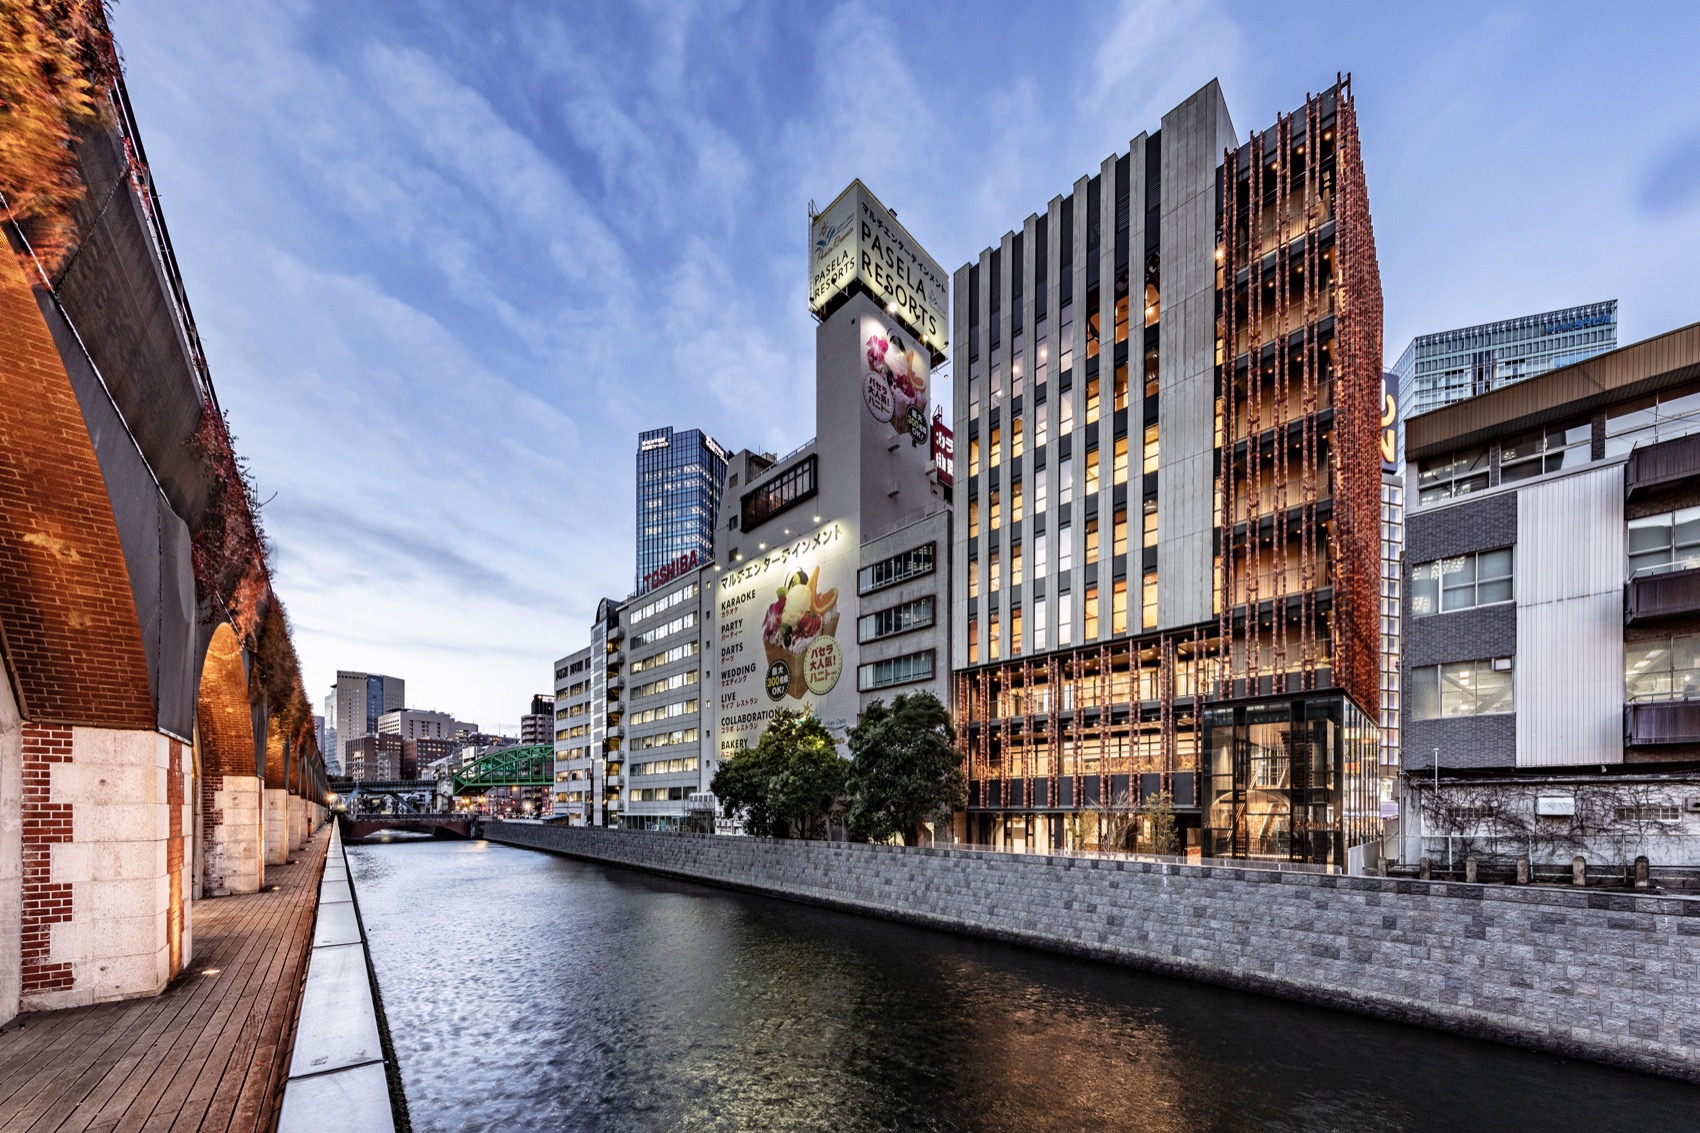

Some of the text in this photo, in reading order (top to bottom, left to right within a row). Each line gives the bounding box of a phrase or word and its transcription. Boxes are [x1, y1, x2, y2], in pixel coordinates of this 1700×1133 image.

[815, 250, 848, 286] PASELA
[862, 220, 926, 302] PASELA
[815, 257, 854, 299] RESORTS
[862, 249, 936, 335] RESORTS
[644, 549, 698, 593] TOSHIBA
[721, 589, 755, 610] KARAOKE
[721, 618, 743, 634] PARTY
[721, 642, 743, 657] DARTS
[721, 662, 756, 679] WEDDING
[721, 692, 736, 703] LIVE
[721, 709, 780, 726] COLLABORATION
[721, 738, 748, 750] BAKERY
